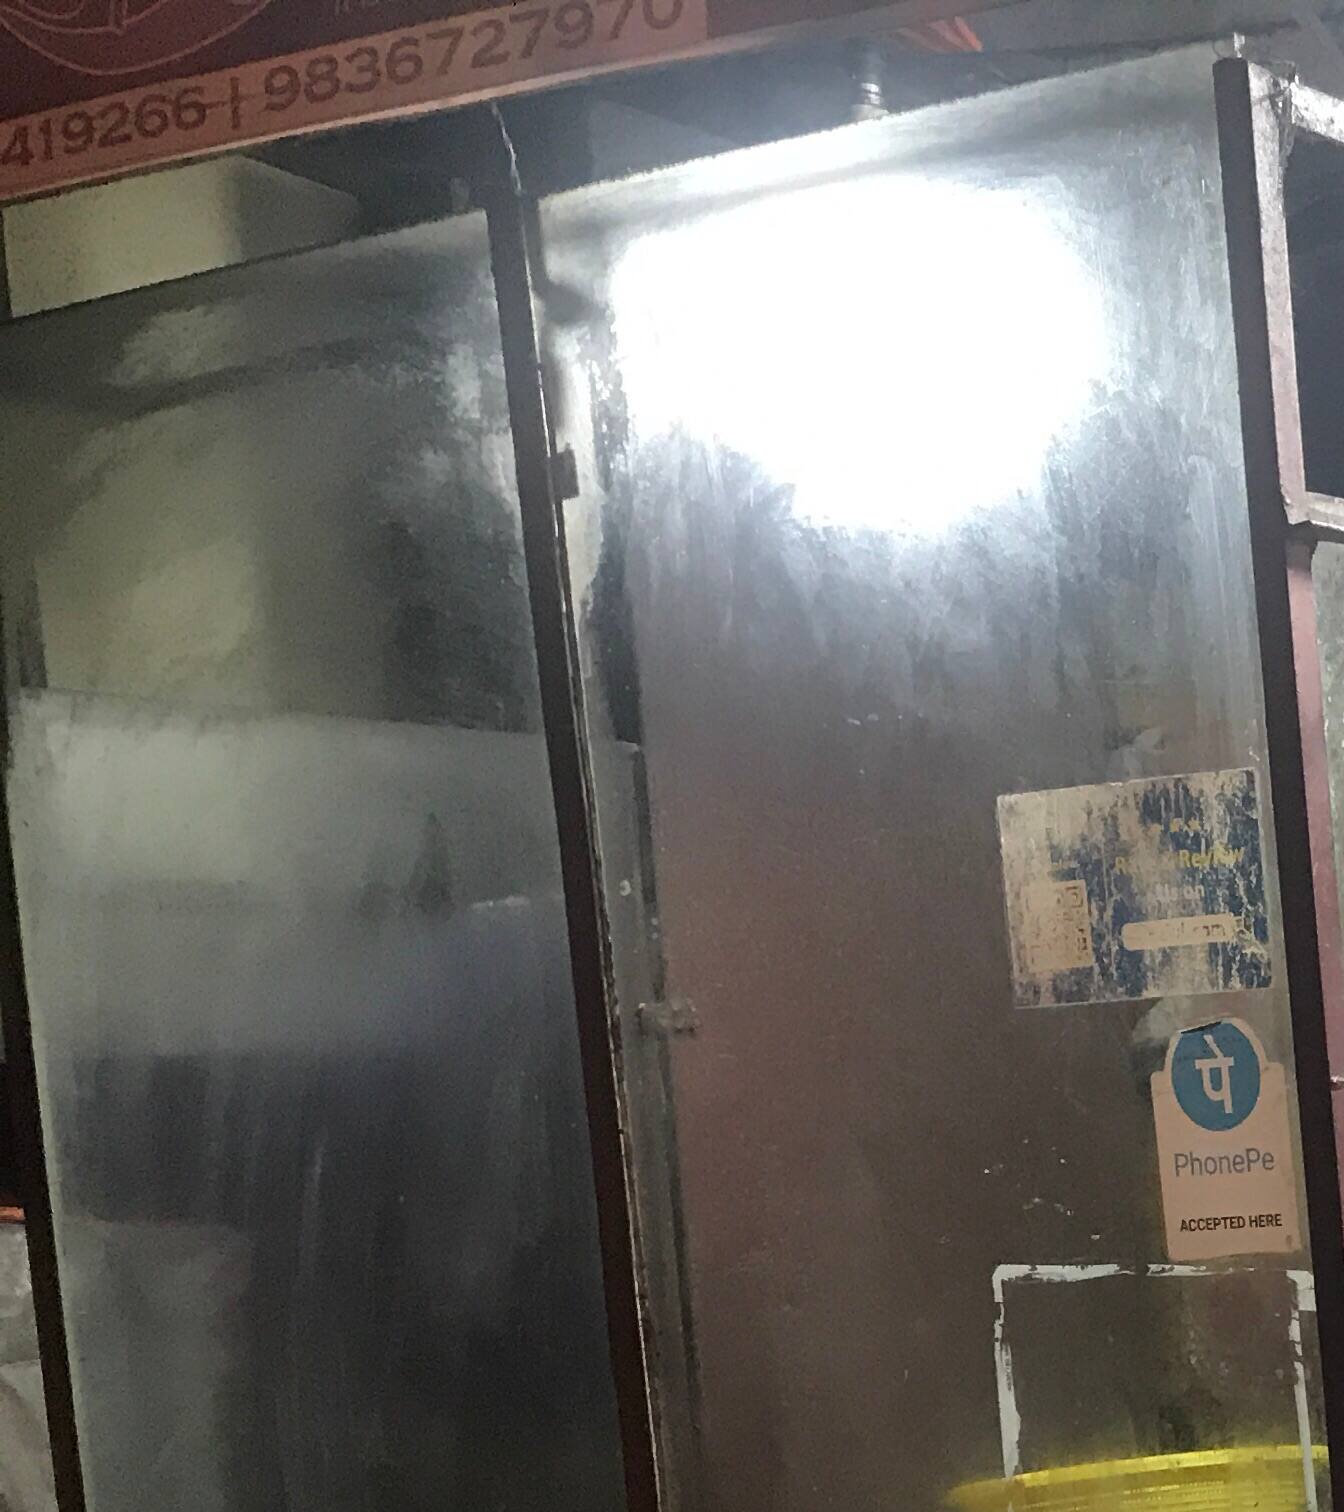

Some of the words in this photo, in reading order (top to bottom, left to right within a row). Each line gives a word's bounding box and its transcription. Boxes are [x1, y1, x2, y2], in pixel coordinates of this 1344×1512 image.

[1174, 1148, 1275, 1177] PhonePe
[1180, 1216, 1245, 1233] ACCEPTED
[1249, 1213, 1283, 1228] HERE
